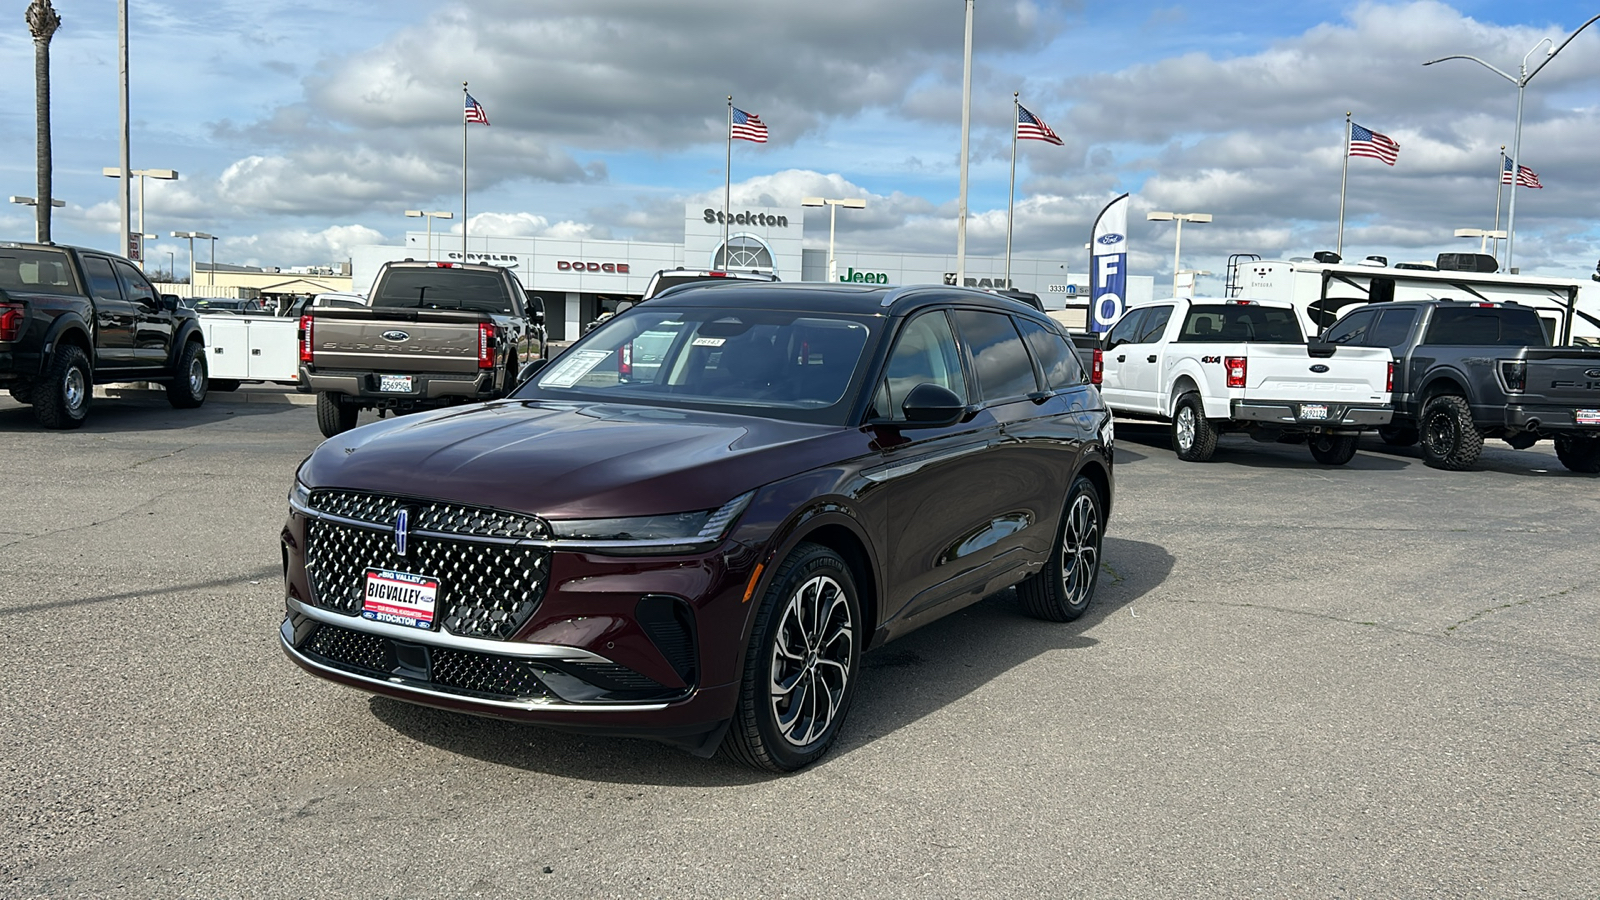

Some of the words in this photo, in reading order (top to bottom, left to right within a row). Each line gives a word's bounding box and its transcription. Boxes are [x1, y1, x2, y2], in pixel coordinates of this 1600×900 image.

[703, 208, 788, 228] Stockton
[448, 252, 518, 262] CHRYSLER
[557, 261, 630, 274] DODGE
[840, 267, 889, 285] Jeep
[964, 277, 1013, 289] RAM
[1049, 285, 1066, 293] 3333
[323, 342, 403, 353] SUPER
[408, 344, 470, 355] DUTY
[1277, 382, 1358, 393] F-150
[809, 558, 843, 571] MICHELIN
[396, 573, 420, 582] VALLEY
[368, 582, 421, 604] BIGVALLEY
[377, 612, 416, 626] STOCKTON
